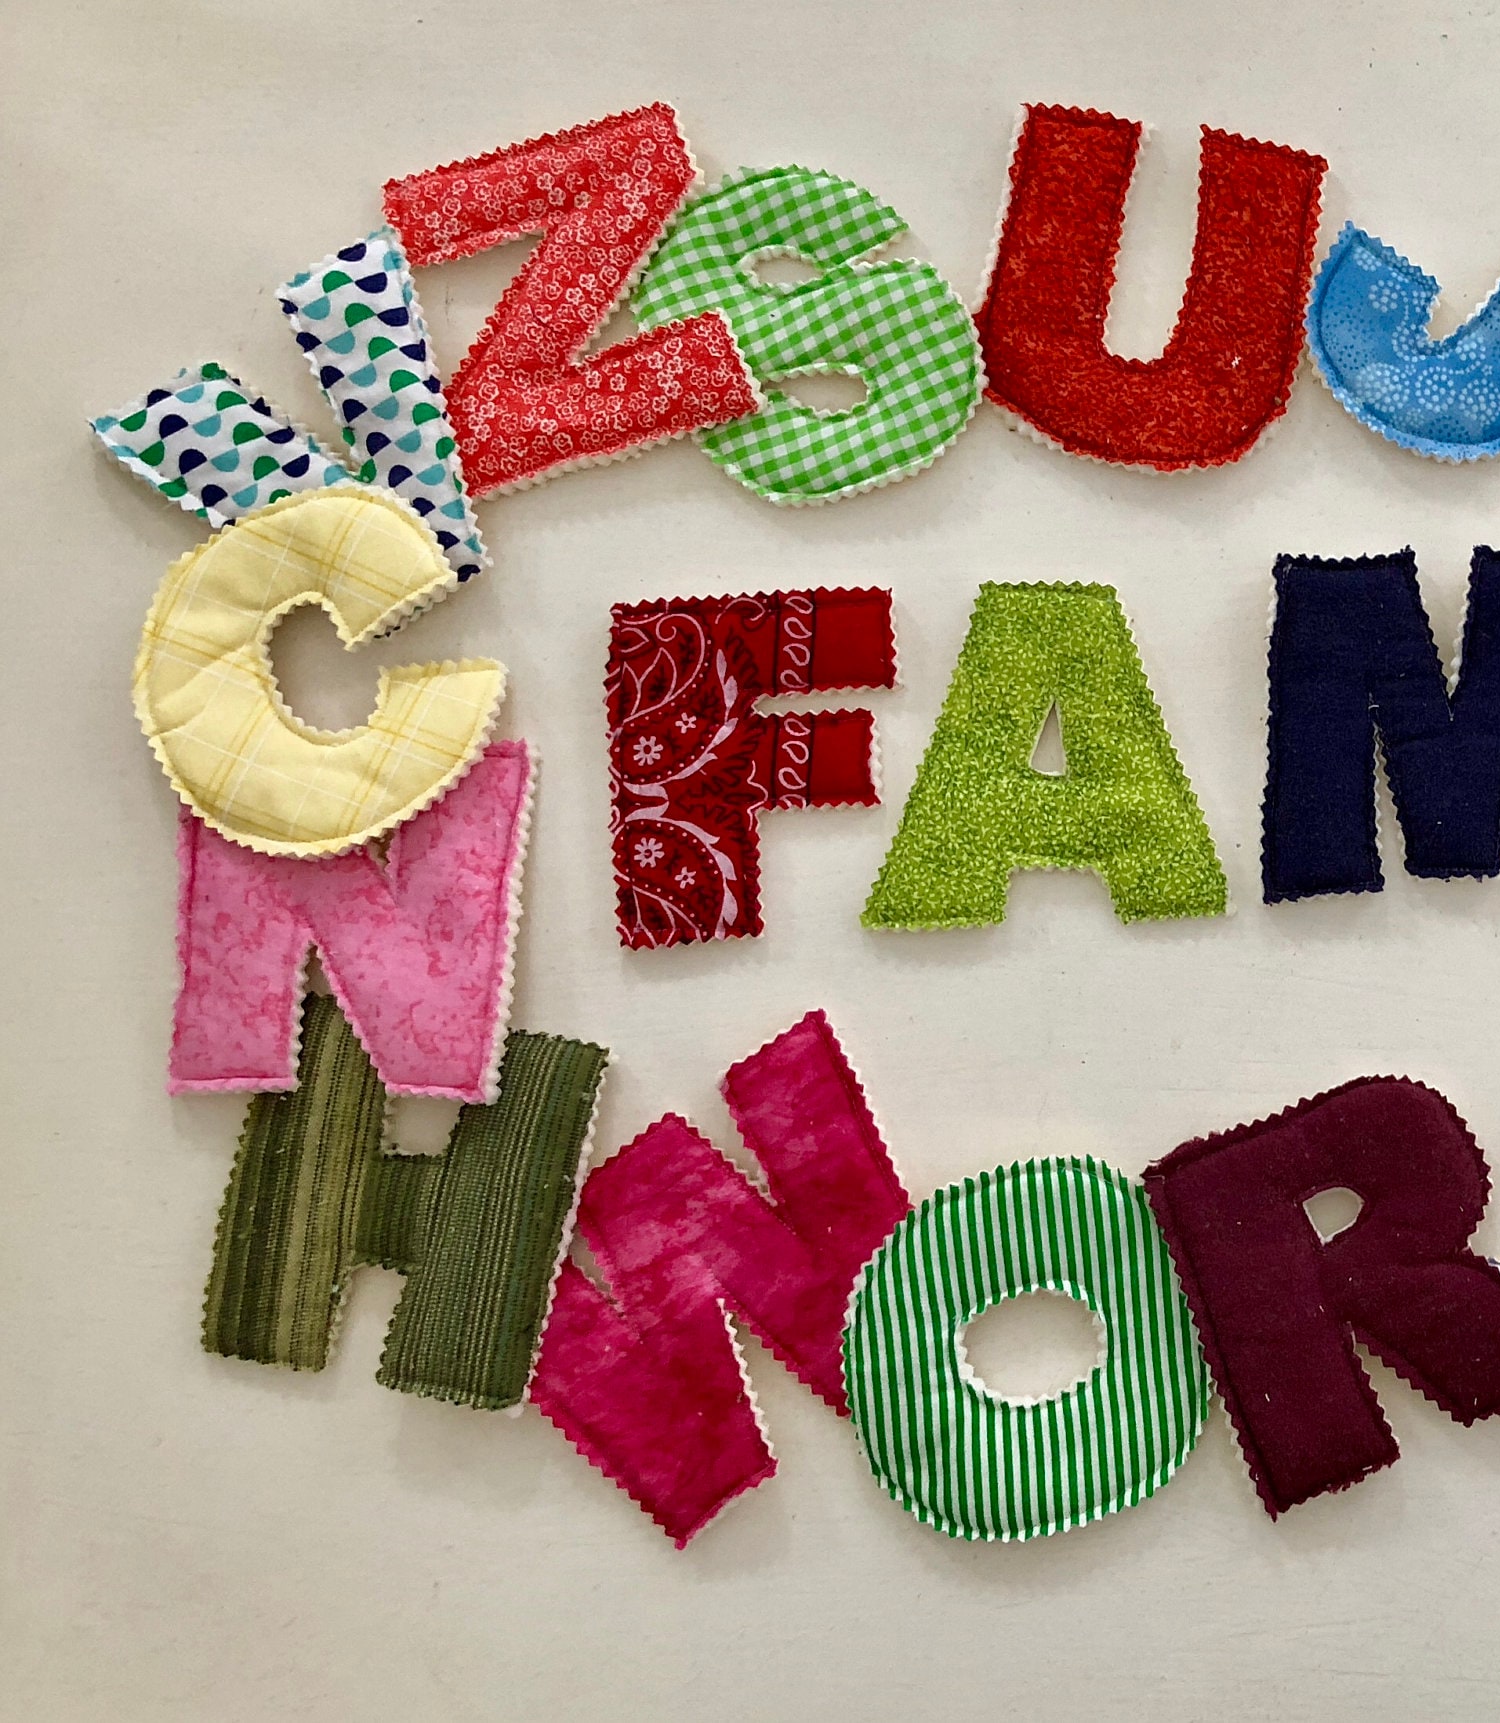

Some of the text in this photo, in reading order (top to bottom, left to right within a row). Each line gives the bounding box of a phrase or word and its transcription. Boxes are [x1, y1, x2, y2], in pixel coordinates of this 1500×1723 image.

[381, 101, 764, 502] Z
[630, 164, 986, 508] S
[976, 101, 1328, 473] U
[131, 483, 510, 860] C
[167, 737, 541, 1105] N
[200, 992, 620, 1417] H
[527, 1007, 914, 1552] W
[840, 1153, 1210, 1541] O
